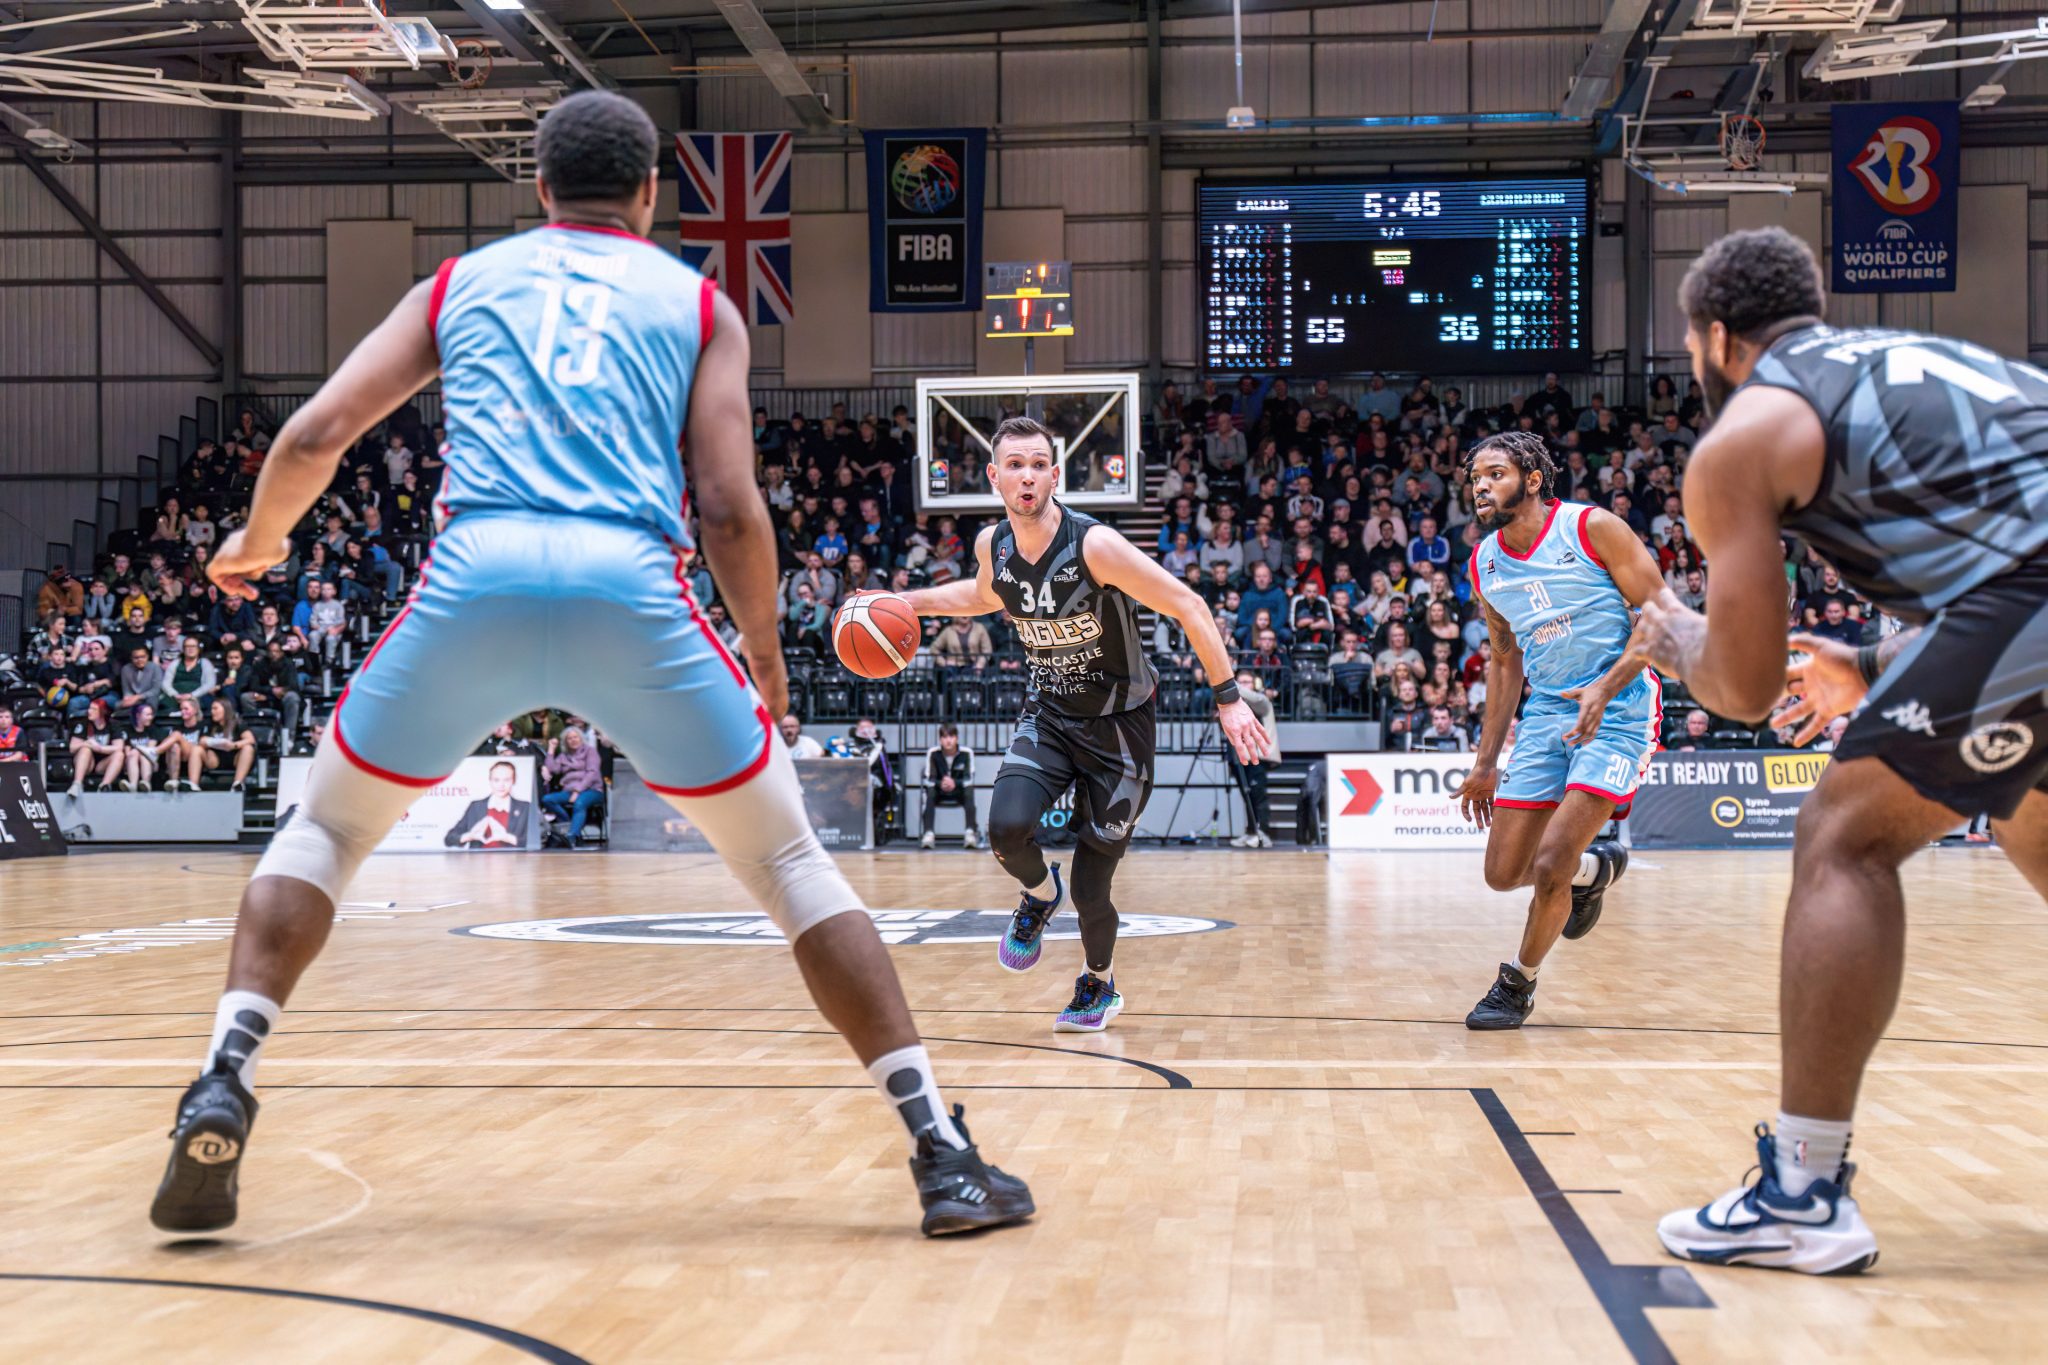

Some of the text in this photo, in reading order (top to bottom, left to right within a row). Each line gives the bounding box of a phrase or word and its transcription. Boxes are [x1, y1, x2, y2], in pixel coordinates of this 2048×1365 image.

[1364, 191, 1441, 217] 5:45
[1884, 227, 1908, 239] FIBA
[898, 233, 953, 261] FIBA
[1843, 250, 1949, 266] WORLD CUP
[1844, 267, 1947, 284] QUALIFIERS
[533, 277, 613, 386] 13
[1307, 318, 1346, 343] 55
[1439, 316, 1480, 341] 36
[1019, 580, 1057, 614] 34
[1524, 580, 1553, 612] 20
[1603, 754, 1632, 788] 20
[1672, 762, 1730, 785] READY
[1733, 762, 1759, 784] TO
[1394, 805, 1449, 816] Forward
[1745, 796, 1770, 807] tyne
